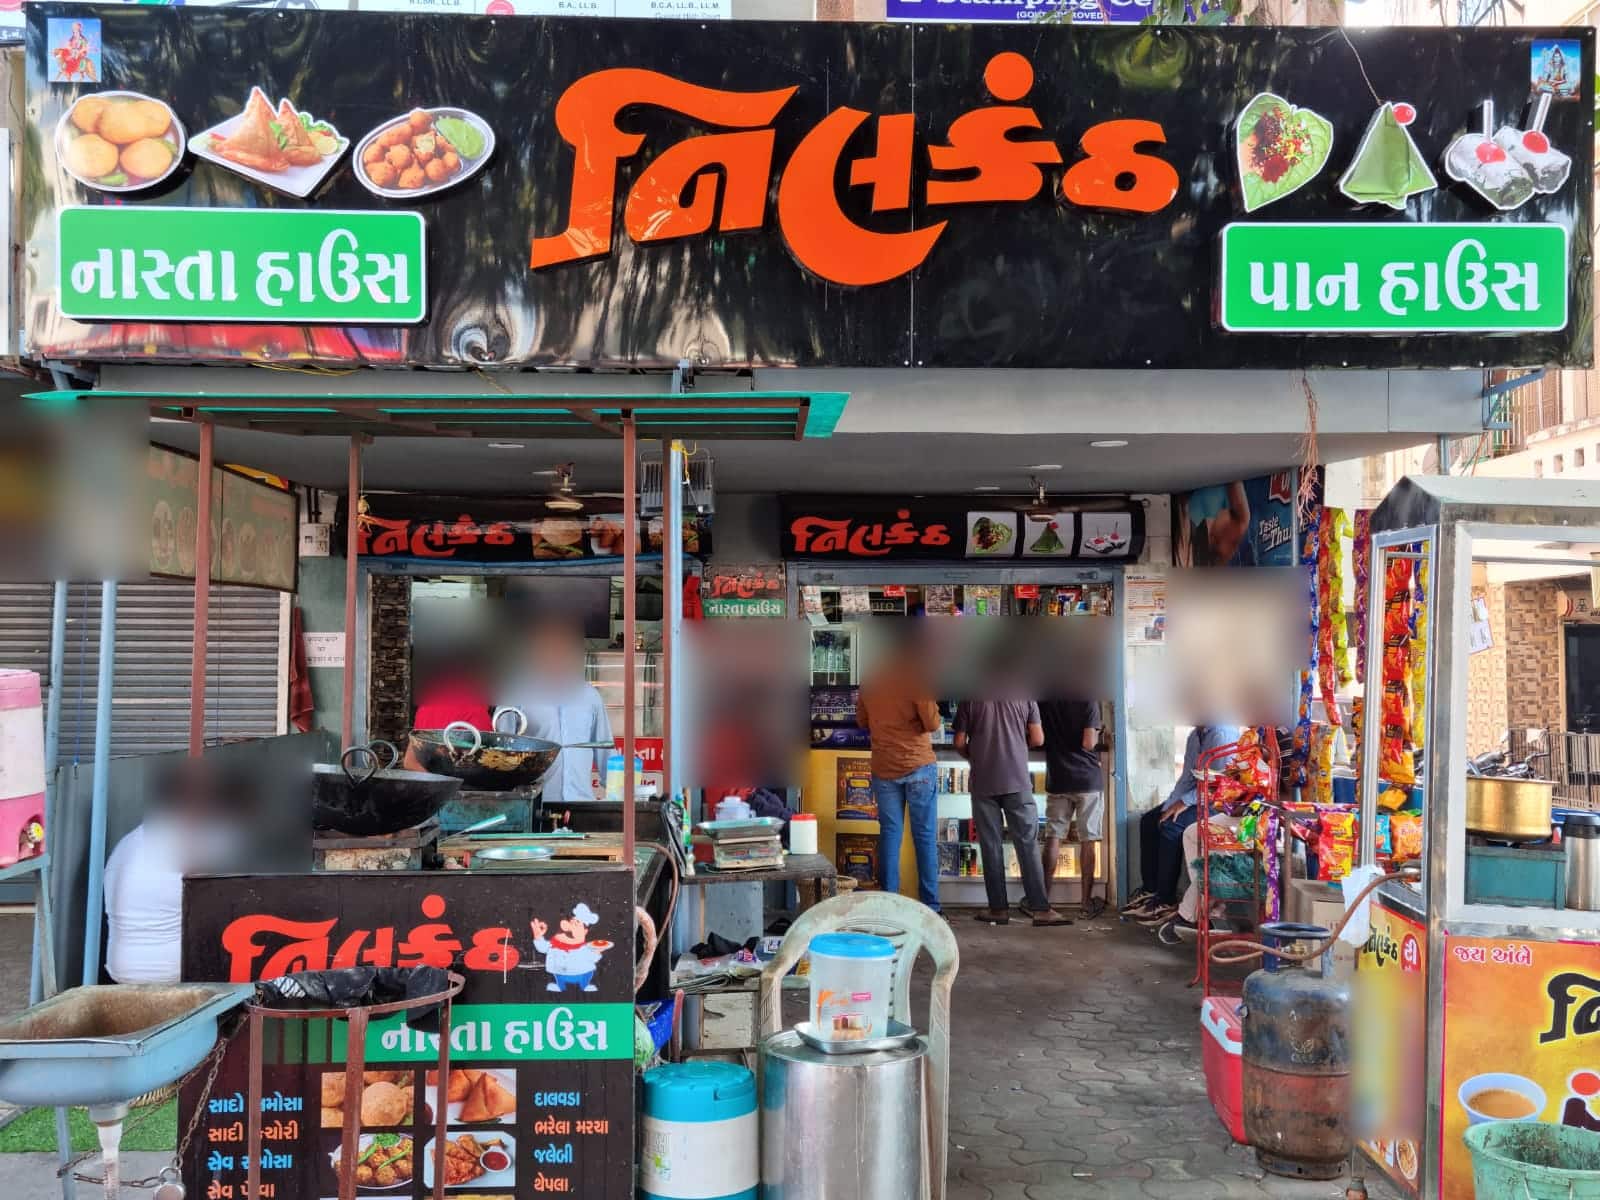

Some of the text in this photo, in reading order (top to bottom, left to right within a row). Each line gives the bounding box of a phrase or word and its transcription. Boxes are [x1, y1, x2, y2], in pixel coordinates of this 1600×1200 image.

[530, 51, 1180, 286] નિલકંઠ
[71, 228, 412, 307] નાસ્તા હાઉસ
[1249, 238, 1542, 316] પાન હાઉસ
[790, 509, 952, 555] નિલકંઠ
[747, 600, 782, 616] હાઉસ
[1453, 944, 1532, 967] જય અંબે
[381, 1006, 609, 1054] નાતા હાઉસ
[208, 1090, 304, 1113] સાદો મોસા
[534, 1091, 580, 1107] દાલવડા
[208, 1119, 299, 1142] સાદી ચોરી
[534, 1114, 609, 1135] ભરેલા મરચા
[207, 1149, 234, 1171] સેવ
[534, 1143, 573, 1164] જલેબી
[207, 1179, 233, 1200] સેવ
[534, 1171, 569, 1192] થેપલા
